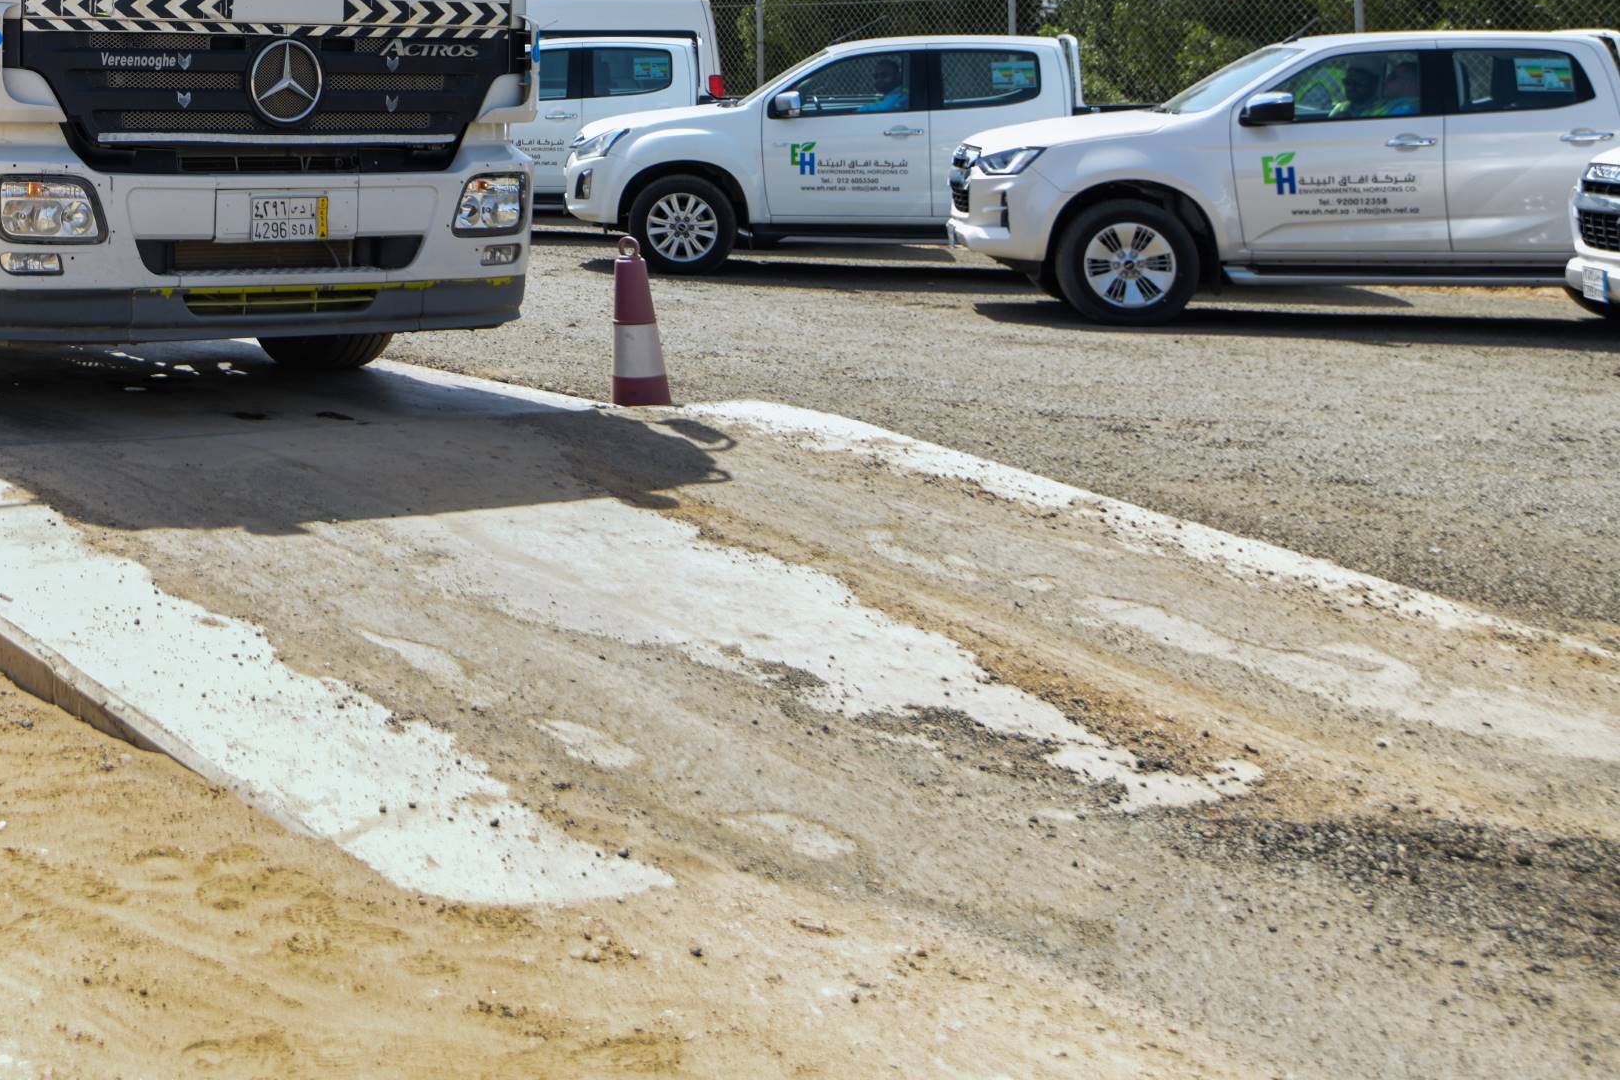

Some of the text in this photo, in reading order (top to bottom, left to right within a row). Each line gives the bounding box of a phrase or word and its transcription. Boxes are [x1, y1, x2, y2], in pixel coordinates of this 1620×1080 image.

[101, 52, 176, 70] Vereenooghe
[1298, 187, 1361, 195] ENVIRONMENTAL
[1292, 208, 1349, 216] www.eh.net.sa
[254, 221, 287, 239] 4296
